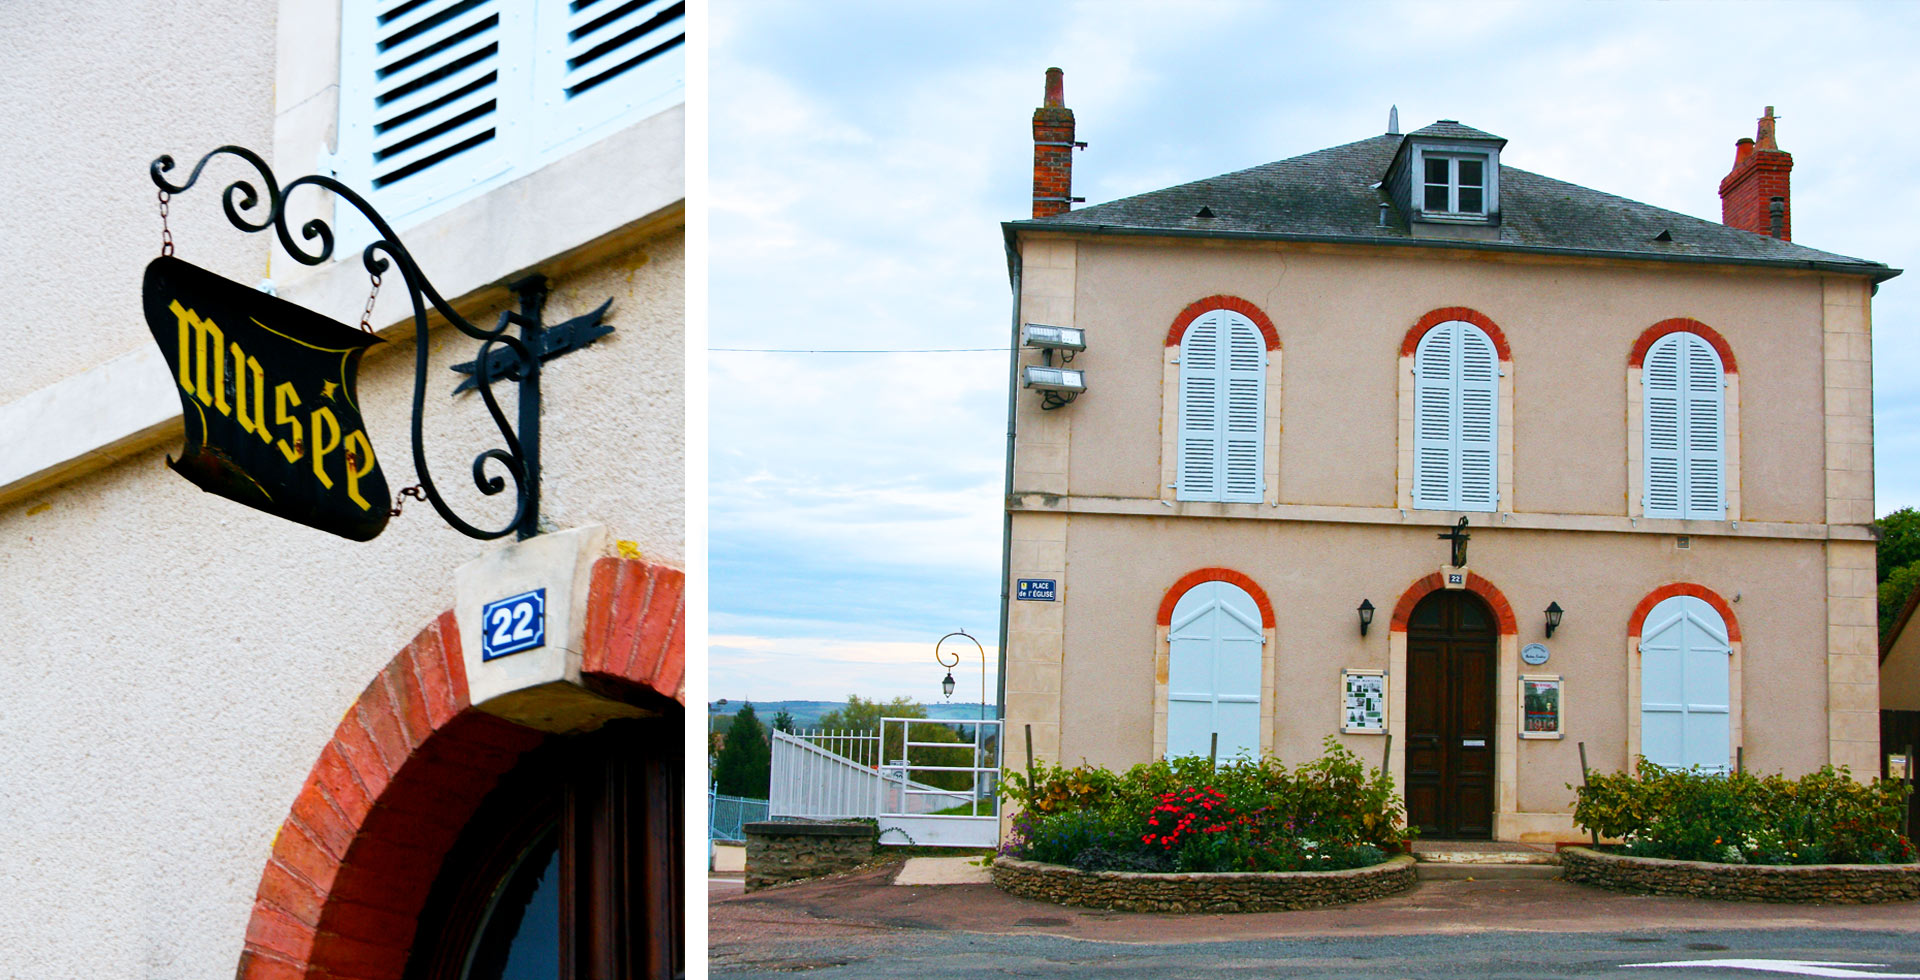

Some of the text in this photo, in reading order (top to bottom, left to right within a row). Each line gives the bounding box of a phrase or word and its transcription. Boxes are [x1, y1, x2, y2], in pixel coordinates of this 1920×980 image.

[168, 299, 375, 512] musée
[1032, 582, 1049, 590] PLACE
[491, 601, 534, 647] 22
